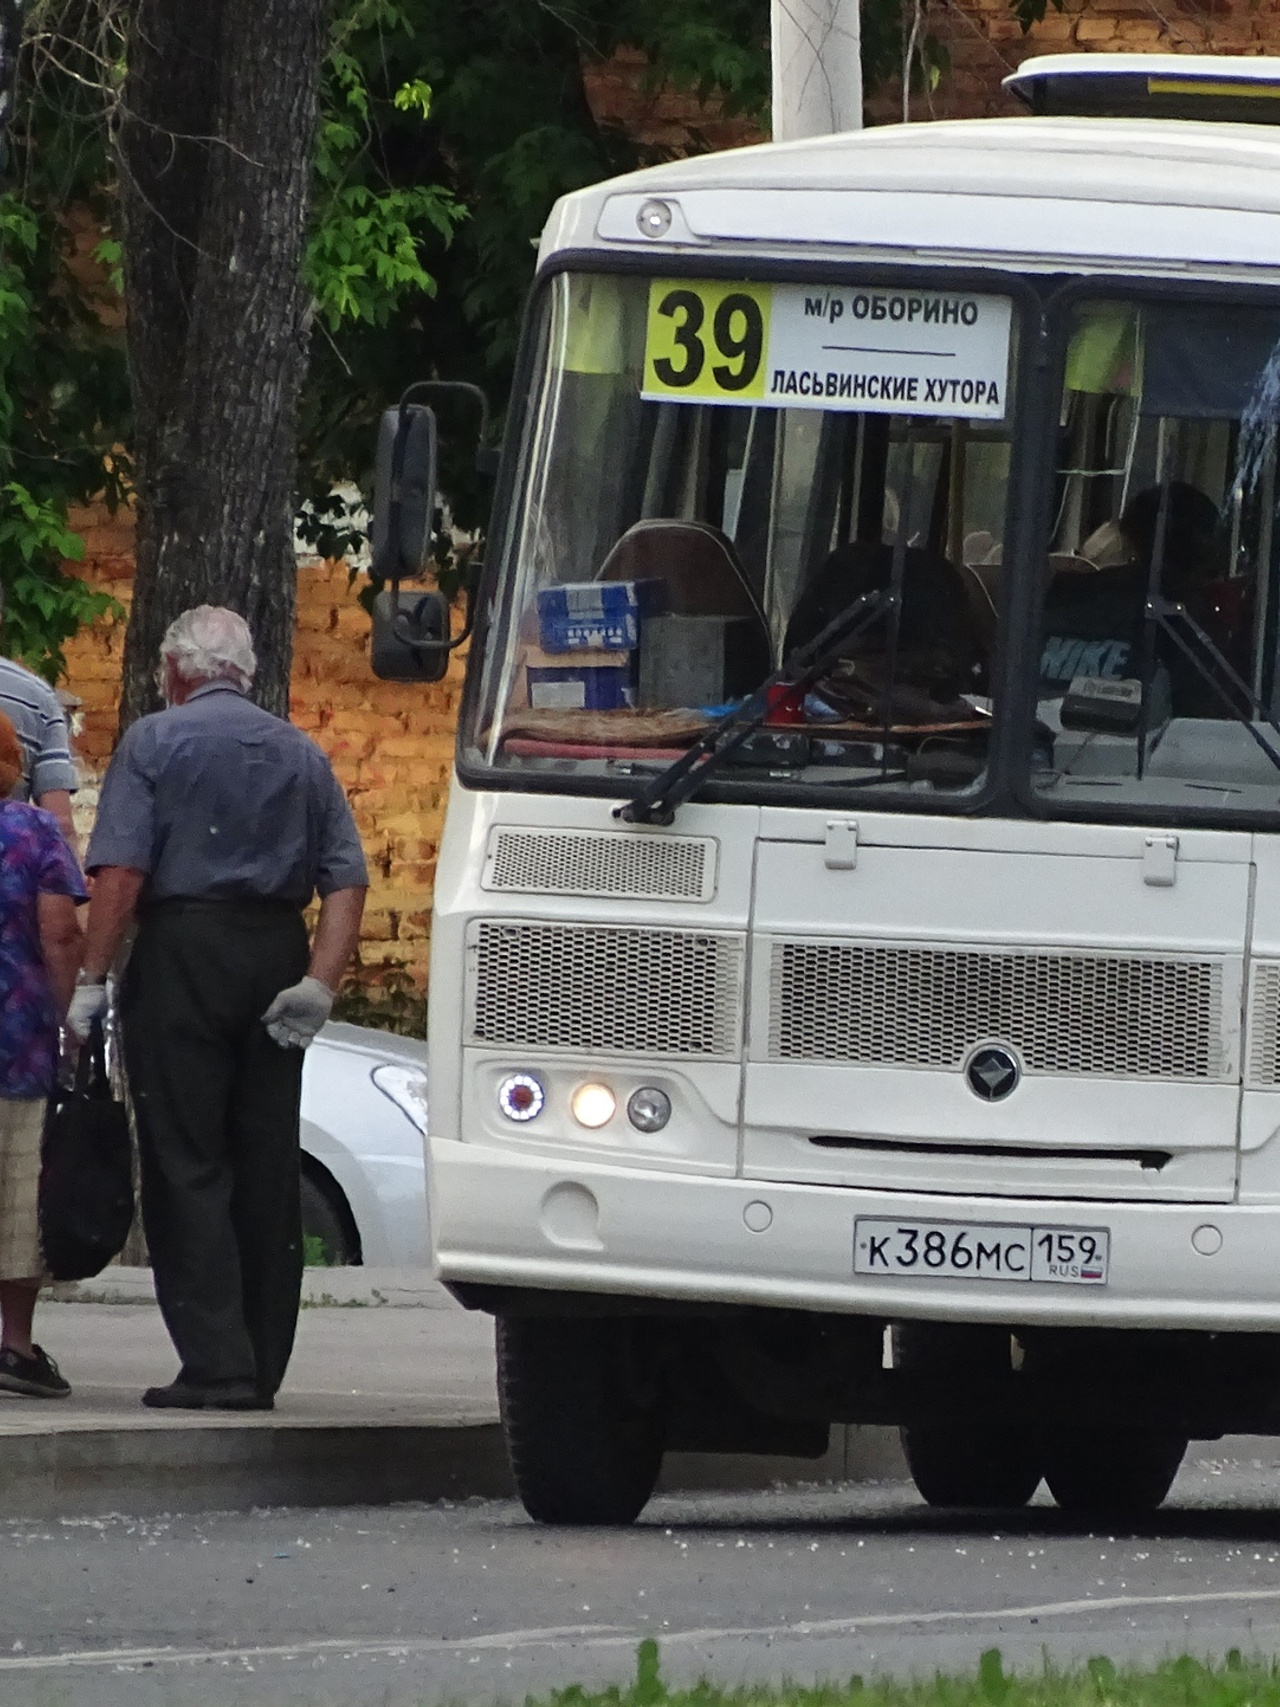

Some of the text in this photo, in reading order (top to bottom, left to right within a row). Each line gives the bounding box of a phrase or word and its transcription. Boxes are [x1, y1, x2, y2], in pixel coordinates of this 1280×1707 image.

[803, 295, 978, 326] м/р ОБОРИНО
[652, 288, 764, 392] 39
[770, 369, 1000, 406] ЛАСЬВИНСКИЕ ХУТОРА
[1040, 635, 1132, 681] NIKE
[868, 1228, 1097, 1272] К386МС 159
[1048, 1264, 1080, 1278] RUS
